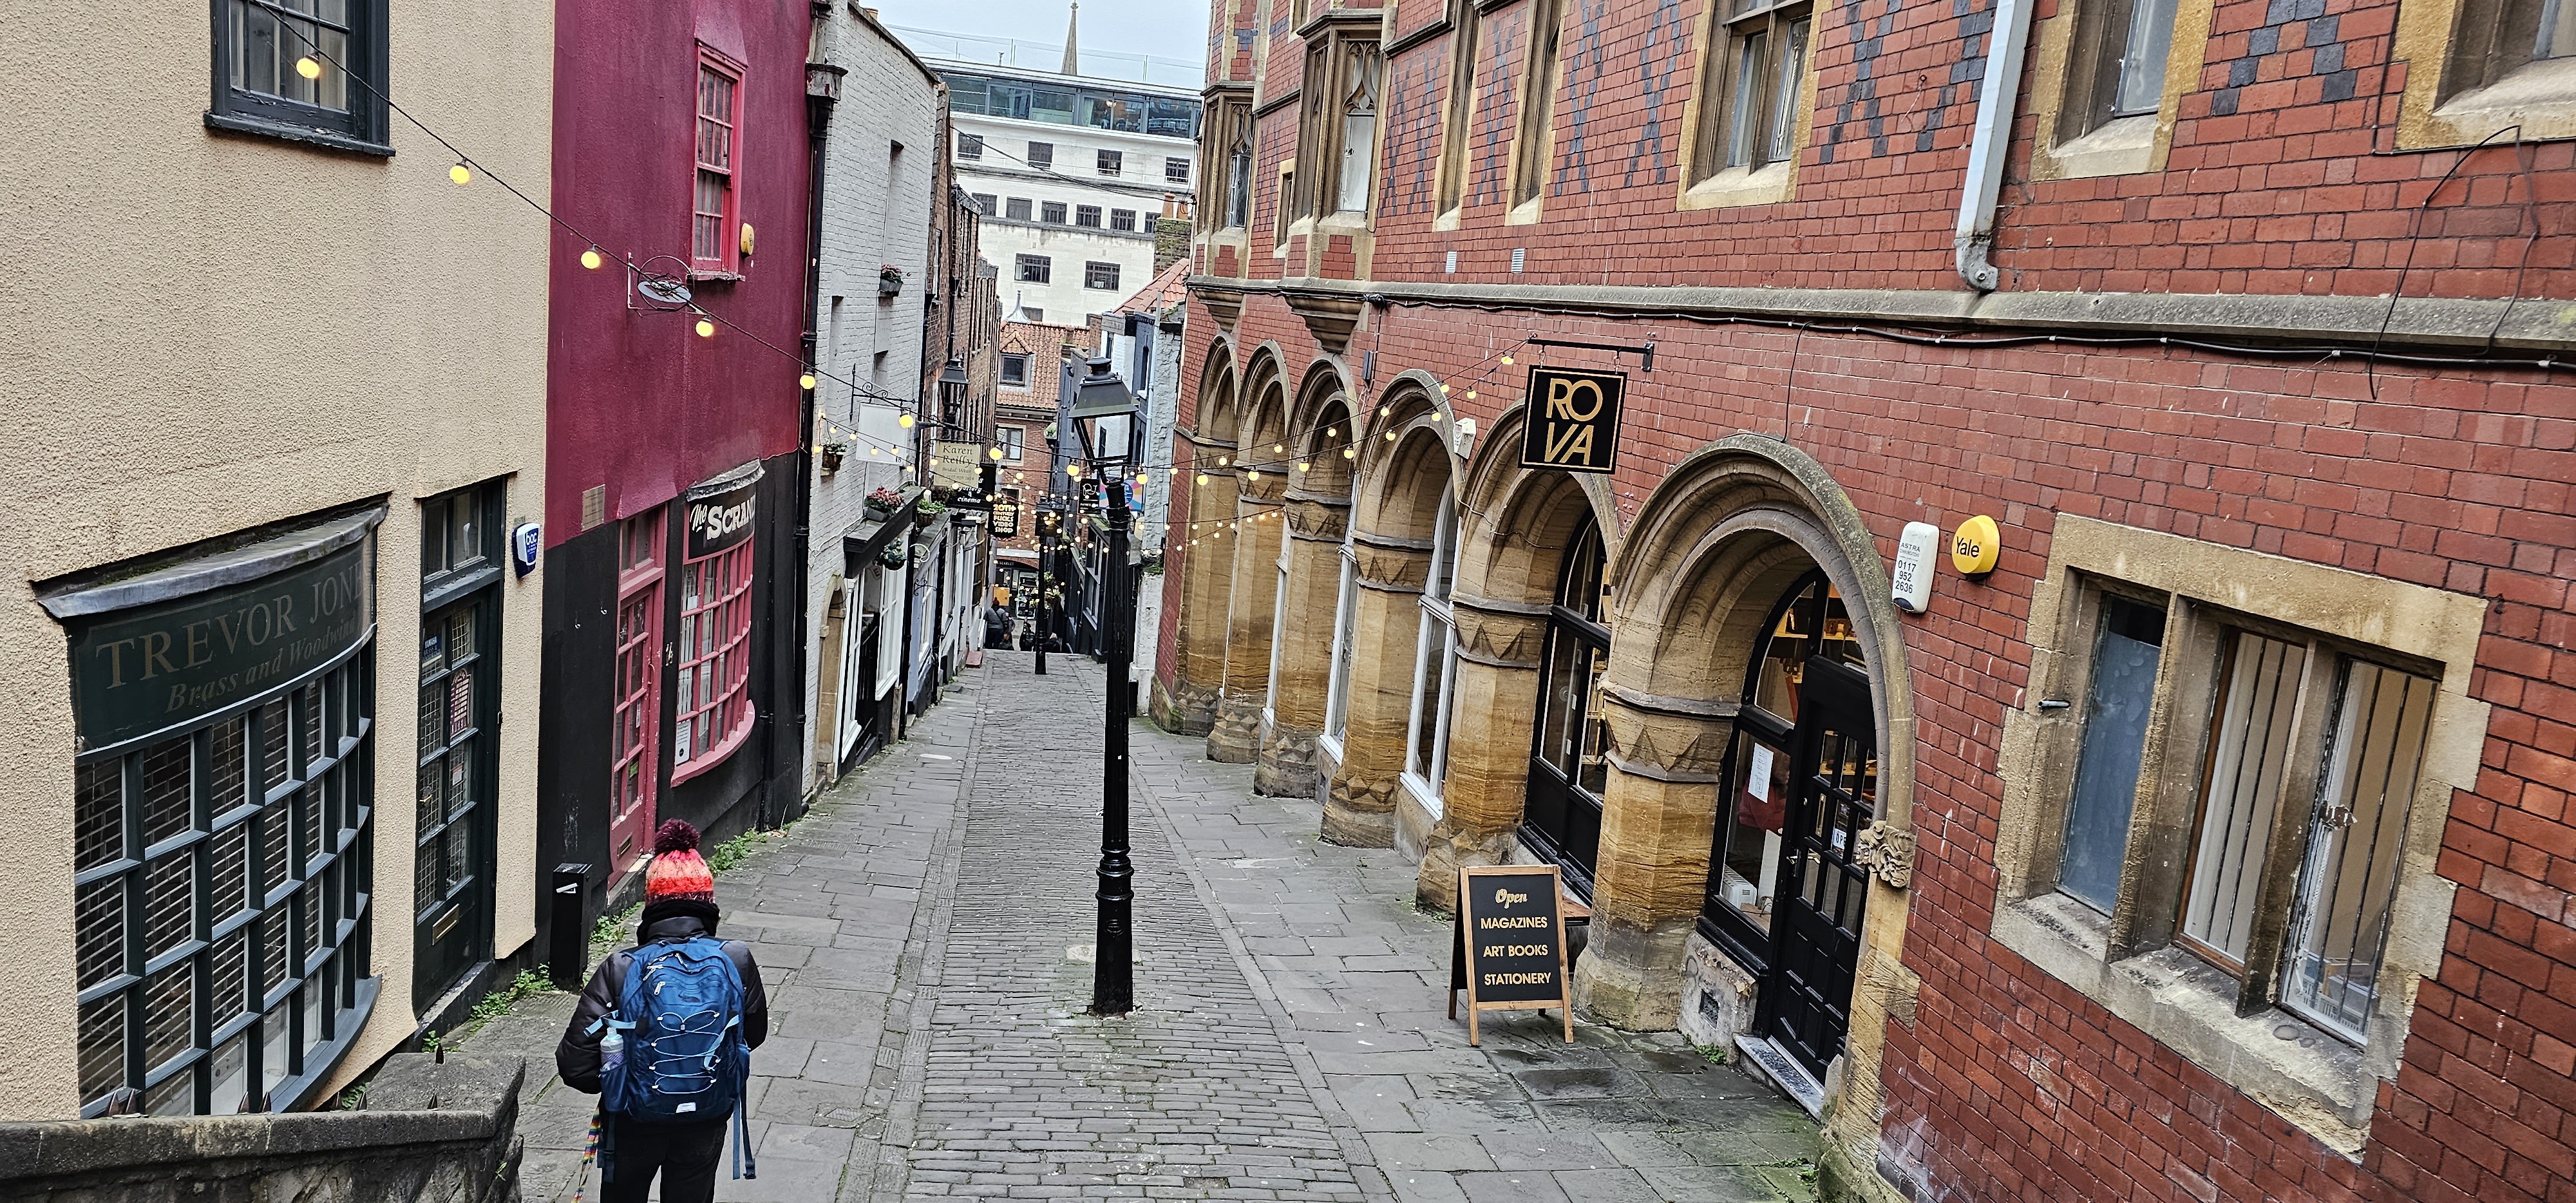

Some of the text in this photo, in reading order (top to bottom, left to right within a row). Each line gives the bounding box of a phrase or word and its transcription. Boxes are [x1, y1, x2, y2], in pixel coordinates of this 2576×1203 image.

[1546, 377, 1603, 421] RO
[943, 445, 972, 455] Karen
[1544, 422, 1595, 465] VA
[942, 455, 972, 468] Reilly
[1900, 543, 1920, 552] ASTRA
[1956, 536, 1980, 558] Yale
[1898, 560, 1917, 573] 0117
[1899, 571, 1912, 582] 952
[1895, 580, 1913, 594] 2636
[96, 594, 297, 689] TREVOR
[164, 673, 238, 714] Brass
[245, 647, 283, 685] and
[1495, 888, 1528, 909] Open
[1481, 916, 1548, 929] MAGAZINES
[1483, 945, 1548, 957] ART BOOKS
[1484, 972, 1551, 985] STATIONERY
